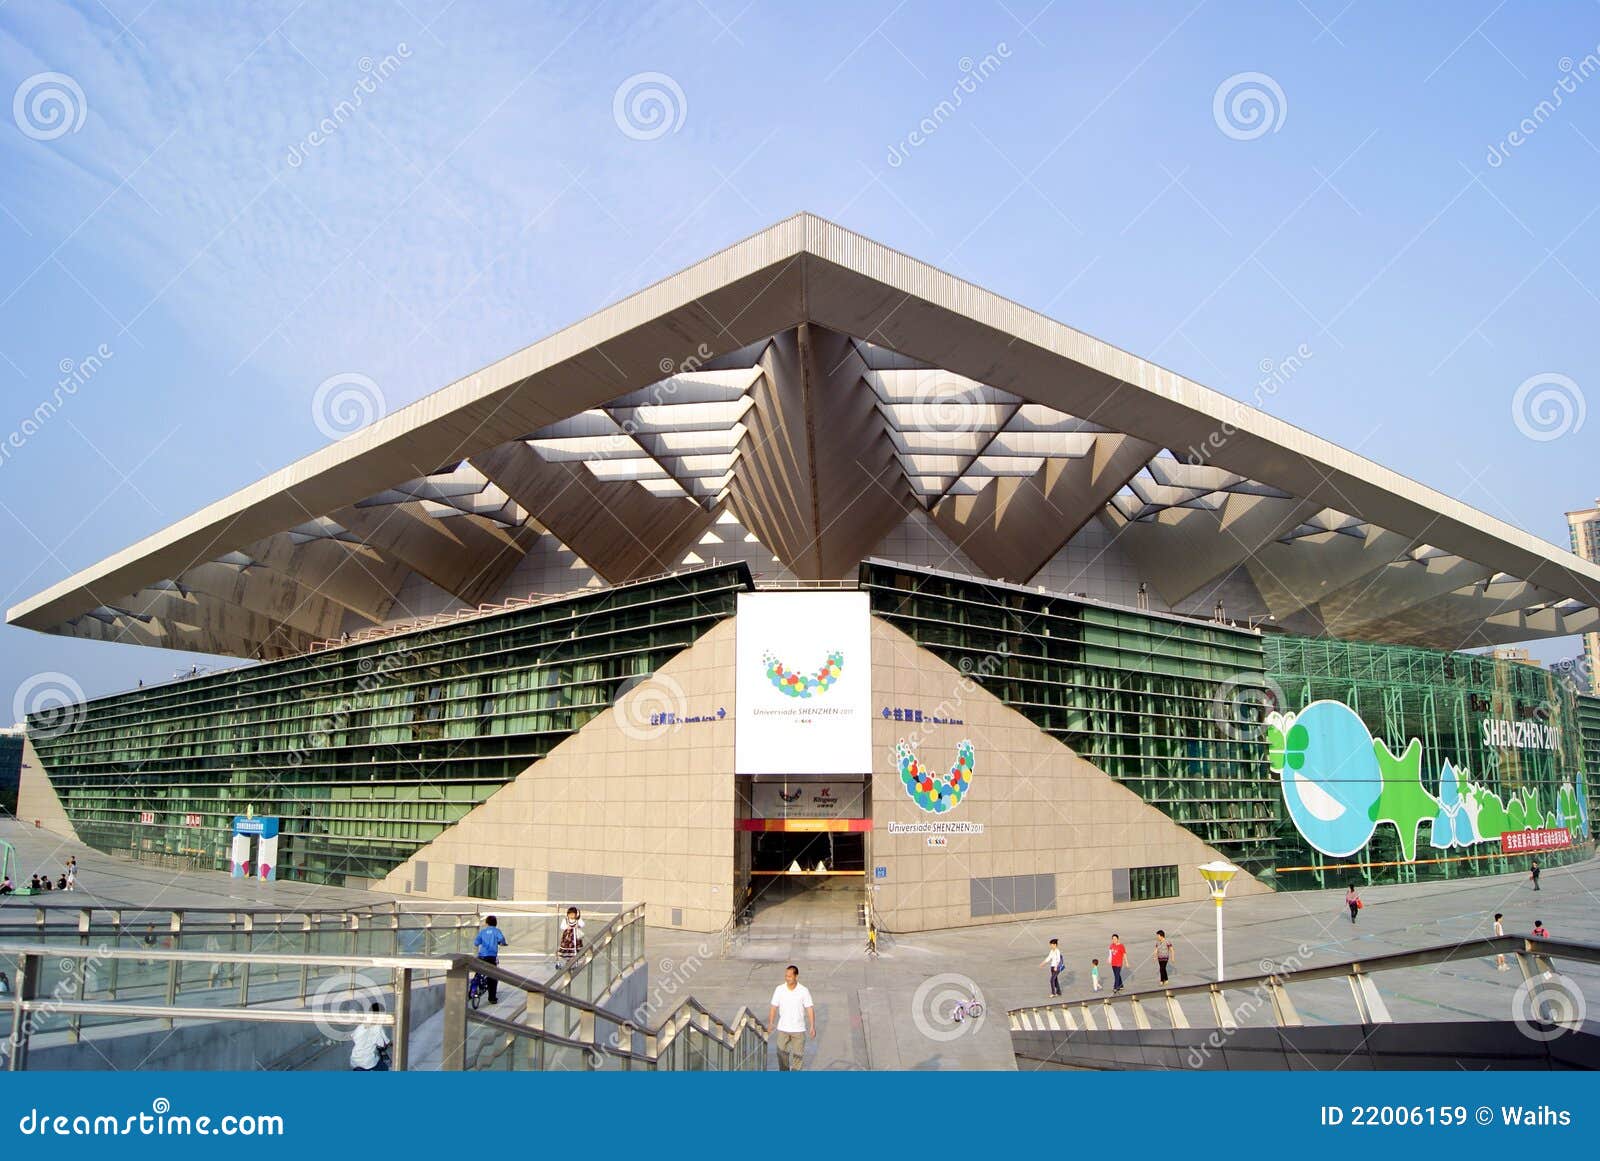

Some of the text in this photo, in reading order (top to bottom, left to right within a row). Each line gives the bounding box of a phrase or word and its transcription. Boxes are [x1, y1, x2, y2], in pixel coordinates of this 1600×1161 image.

[798, 707, 839, 715] SHENZHEN
[1483, 719, 1544, 749] SHENZHEN
[932, 823, 970, 833] SHENZHEN
